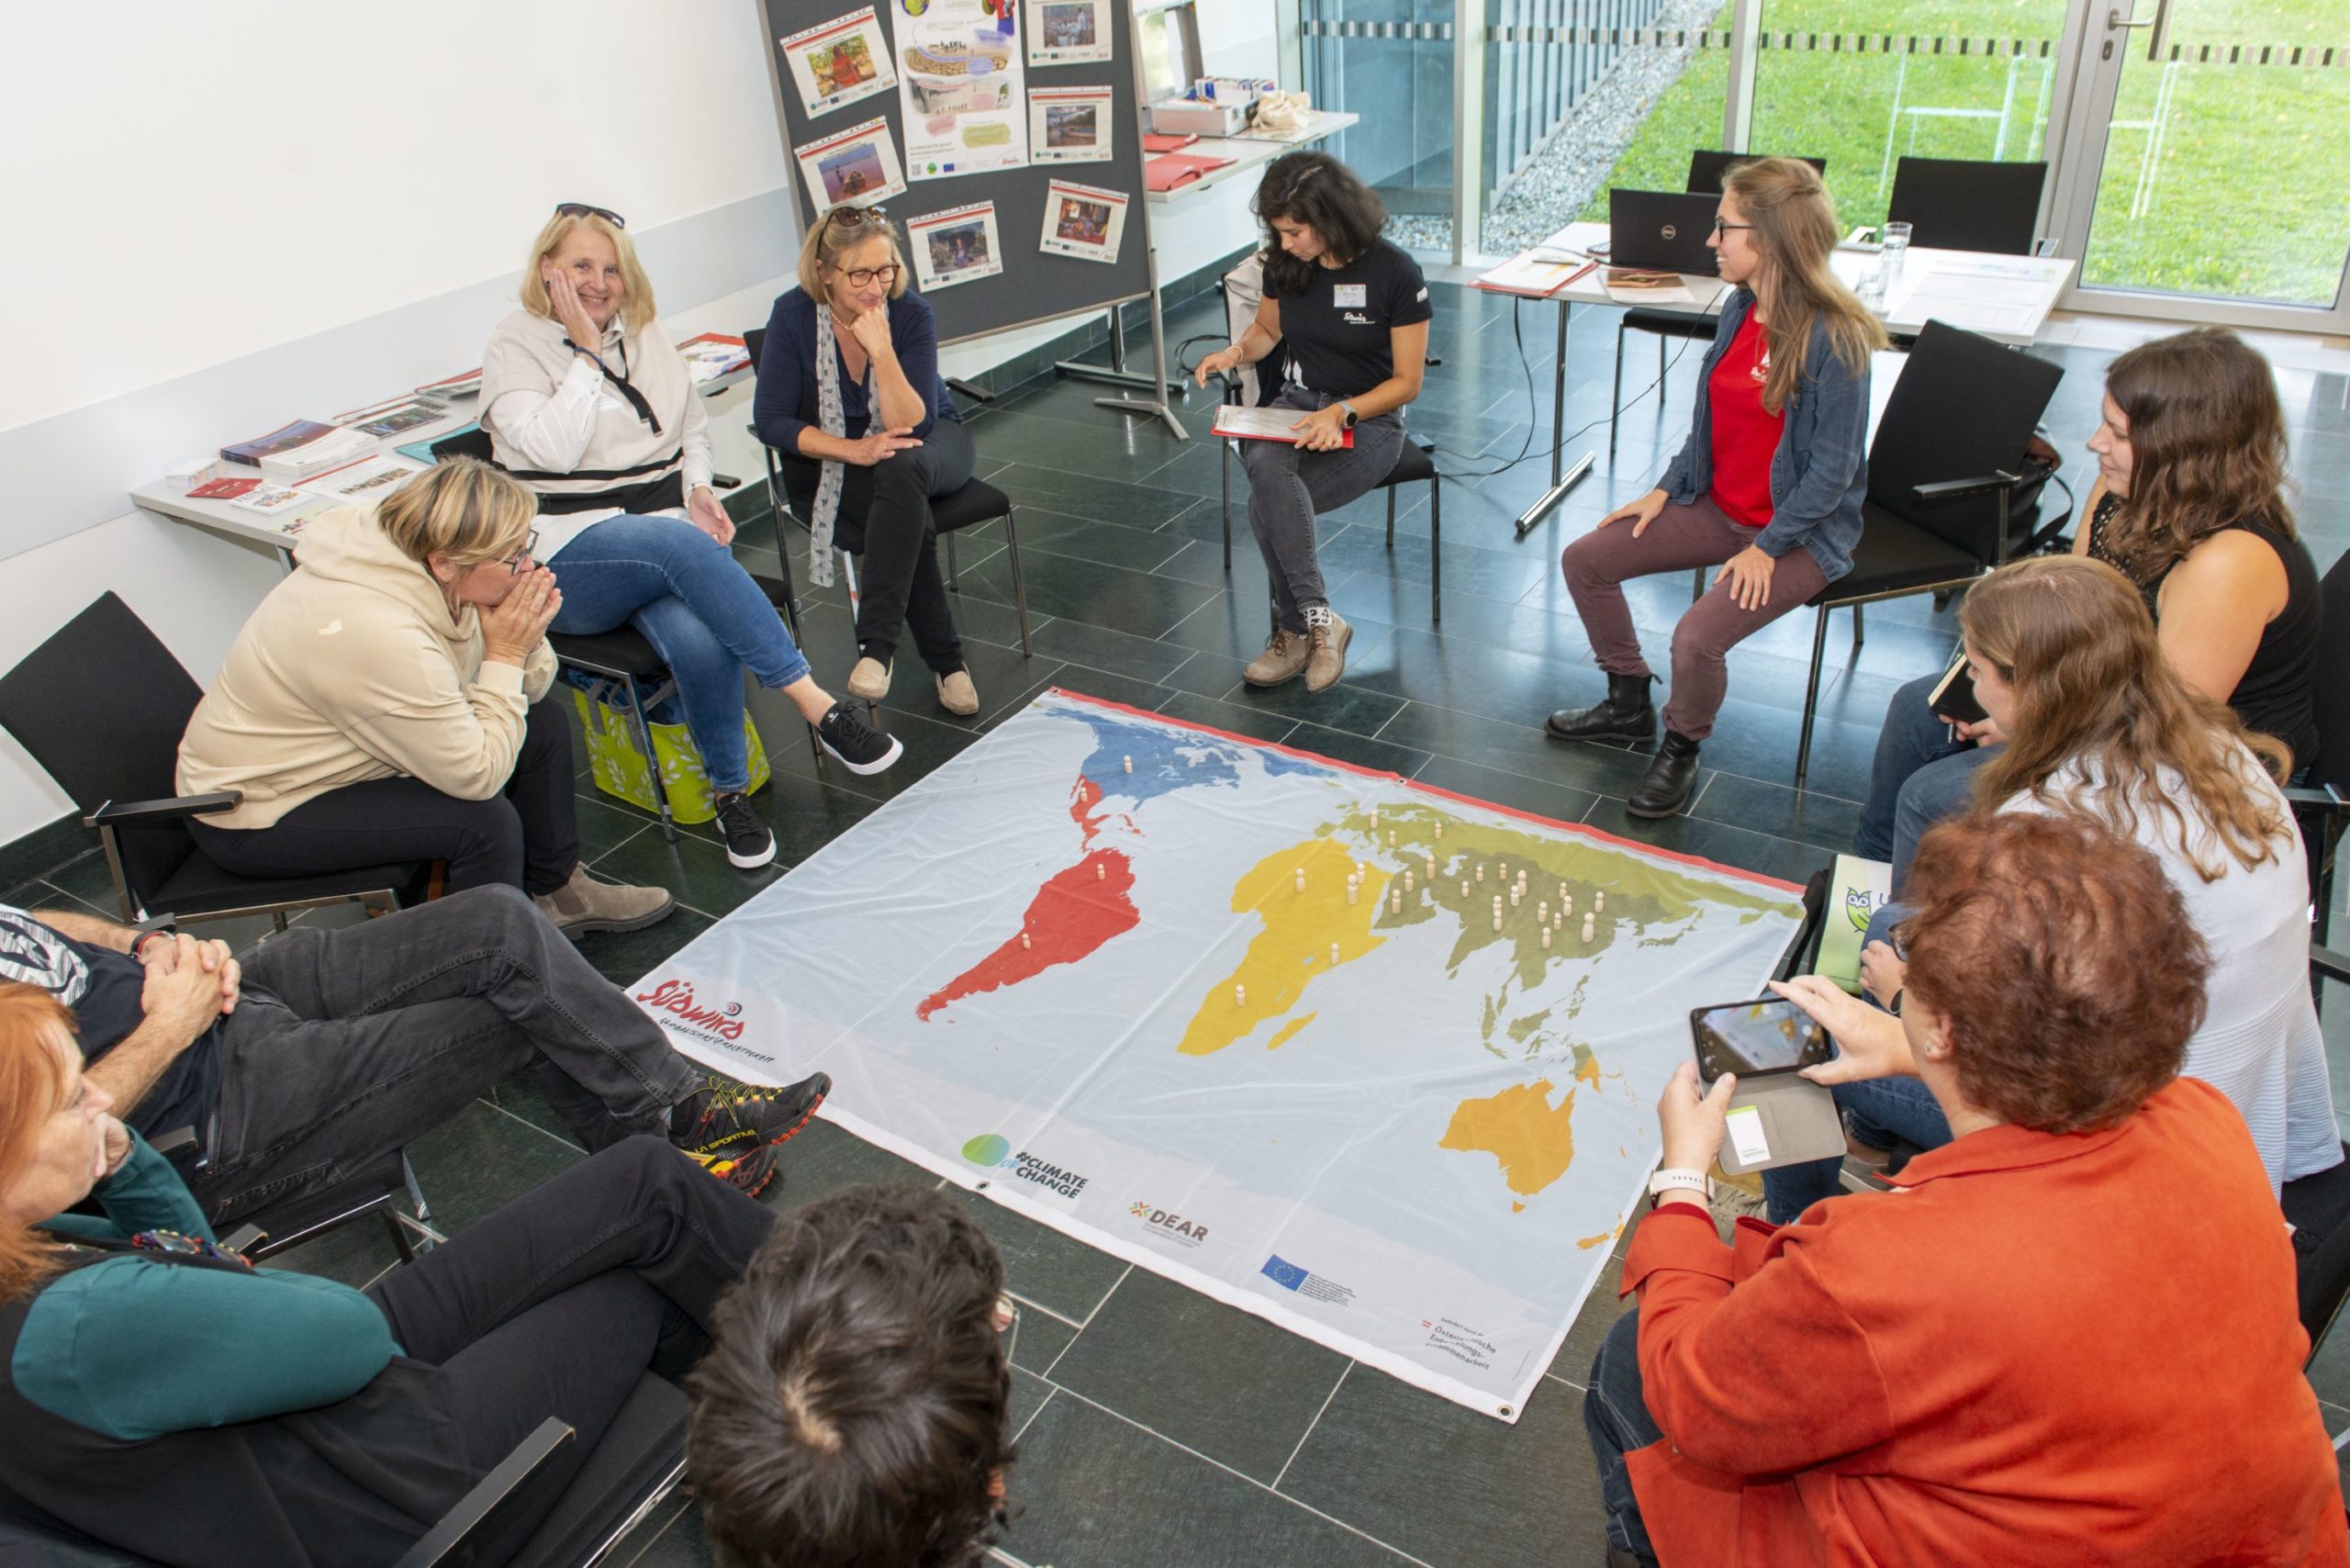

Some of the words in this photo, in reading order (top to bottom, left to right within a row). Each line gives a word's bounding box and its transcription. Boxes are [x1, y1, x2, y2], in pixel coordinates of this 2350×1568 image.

[1015, 1151, 1089, 1189] #CLIMATE
[1015, 1167, 1080, 1199] CHANGE
[1148, 1209, 1209, 1242] DEAR
